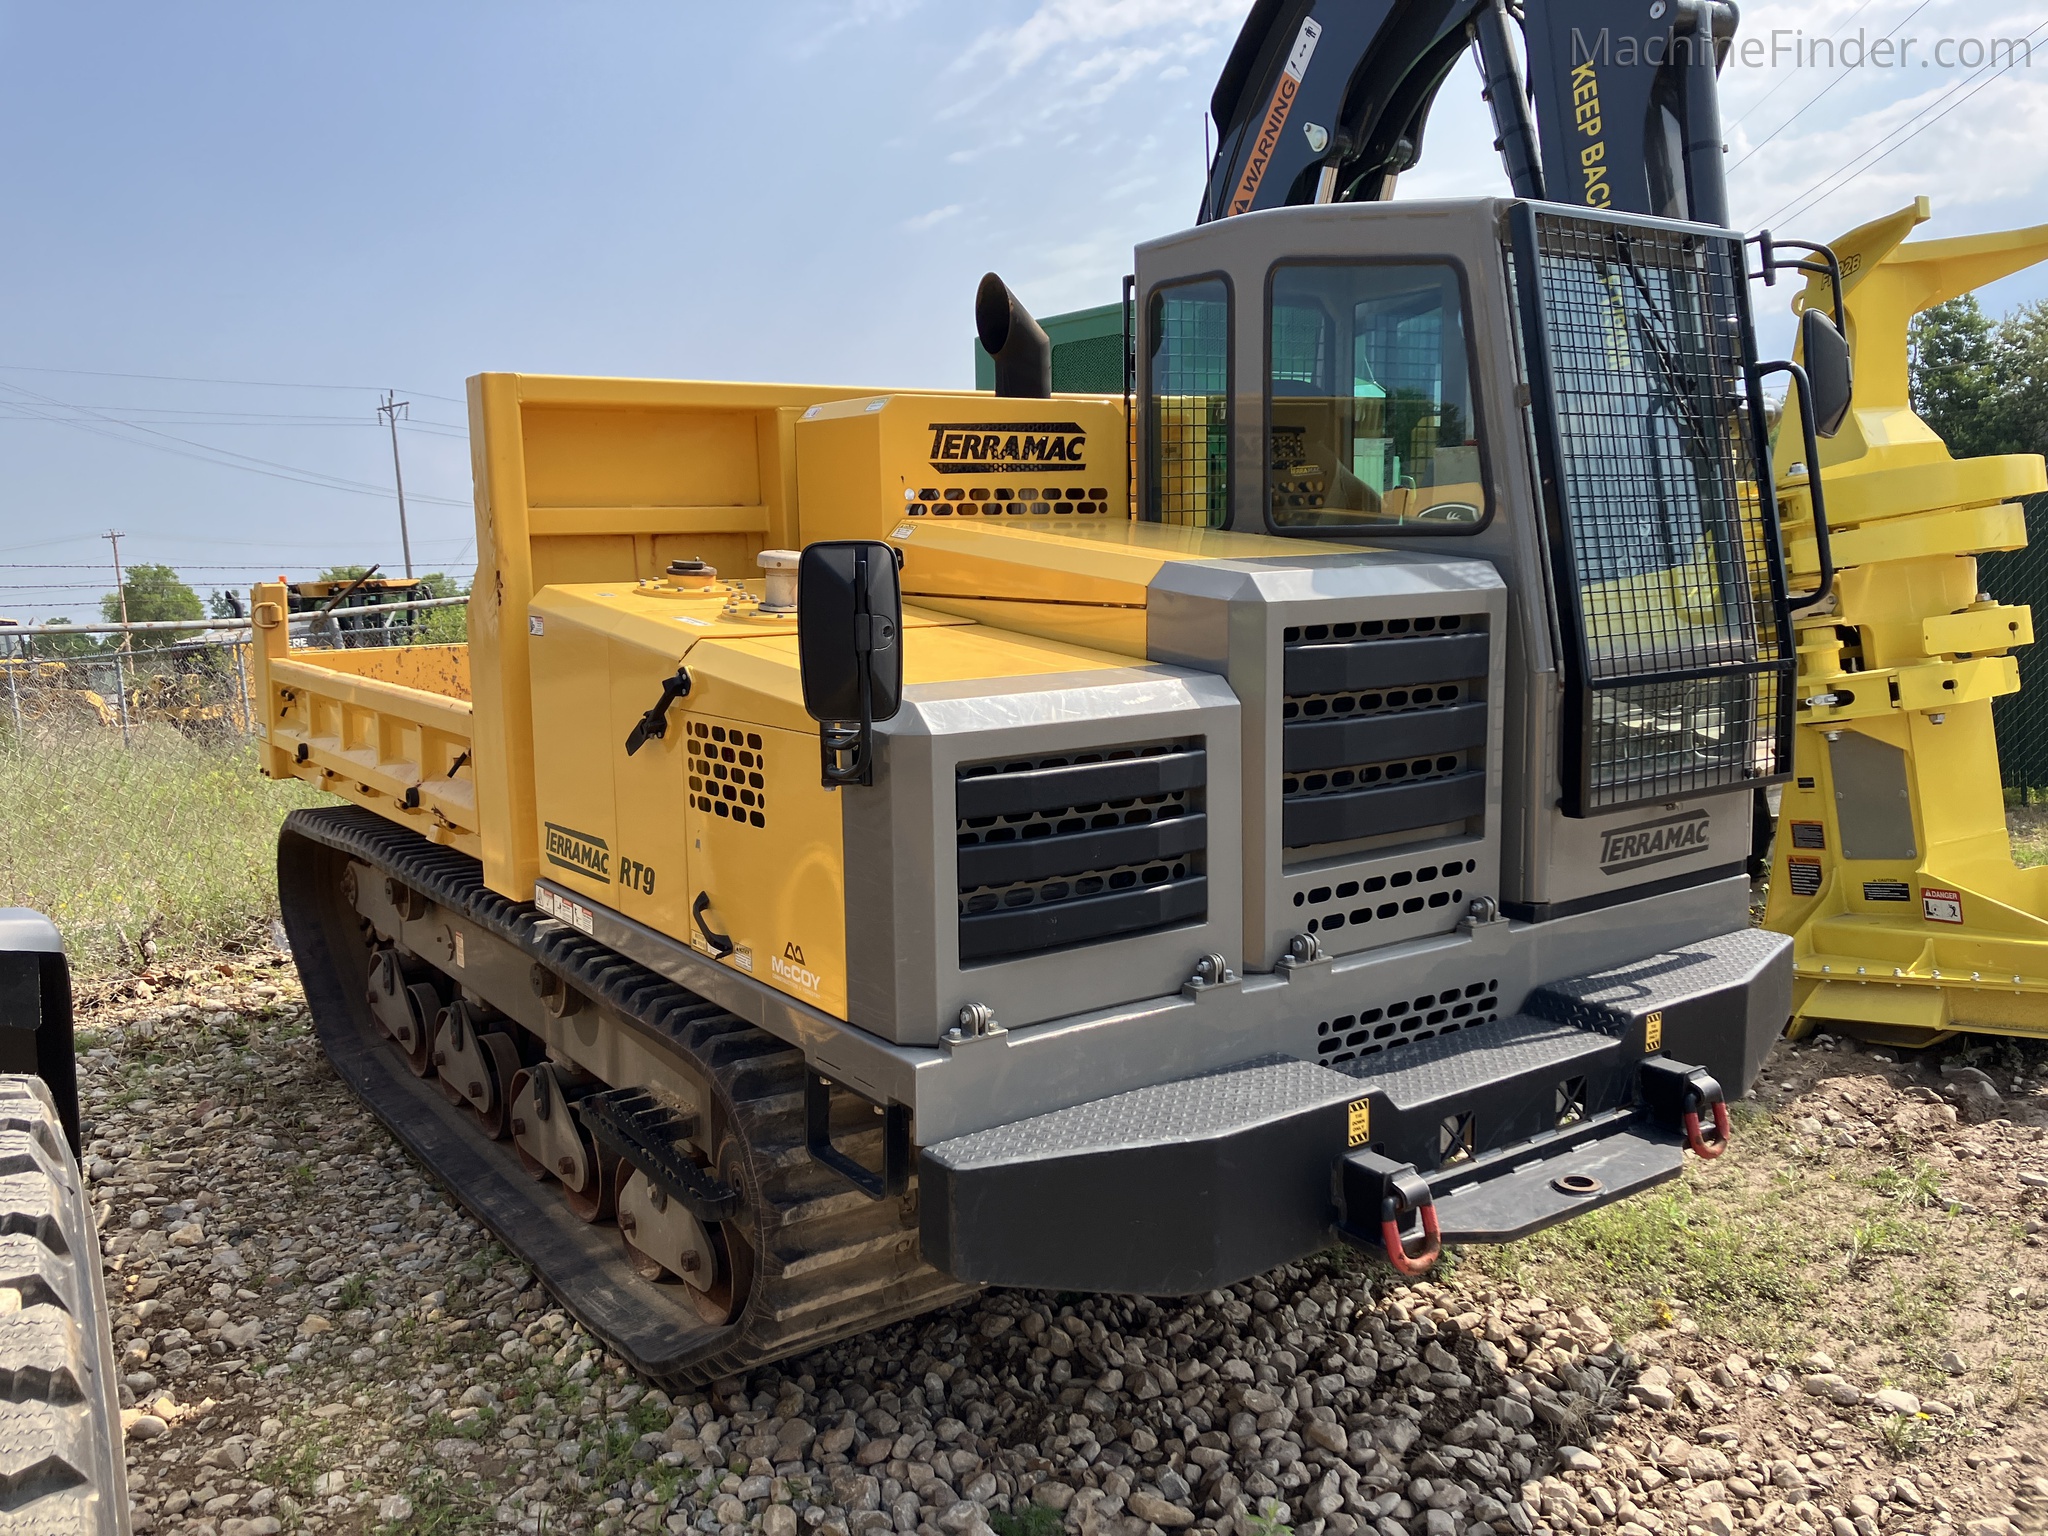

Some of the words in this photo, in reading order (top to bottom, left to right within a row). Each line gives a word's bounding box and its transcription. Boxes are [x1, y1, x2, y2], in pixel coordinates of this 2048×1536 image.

[1571, 59, 1602, 136] KEEP
[1243, 79, 1296, 193] WARNING
[1581, 141, 1611, 208] BAC
[928, 422, 1086, 461] TERRAMAC
[544, 821, 610, 877] TERRAMAC
[620, 856, 655, 895] RT9
[1600, 809, 1710, 870] TERRAMAC
[1931, 890, 1958, 899] DANGER
[771, 955, 821, 990] McCOY
